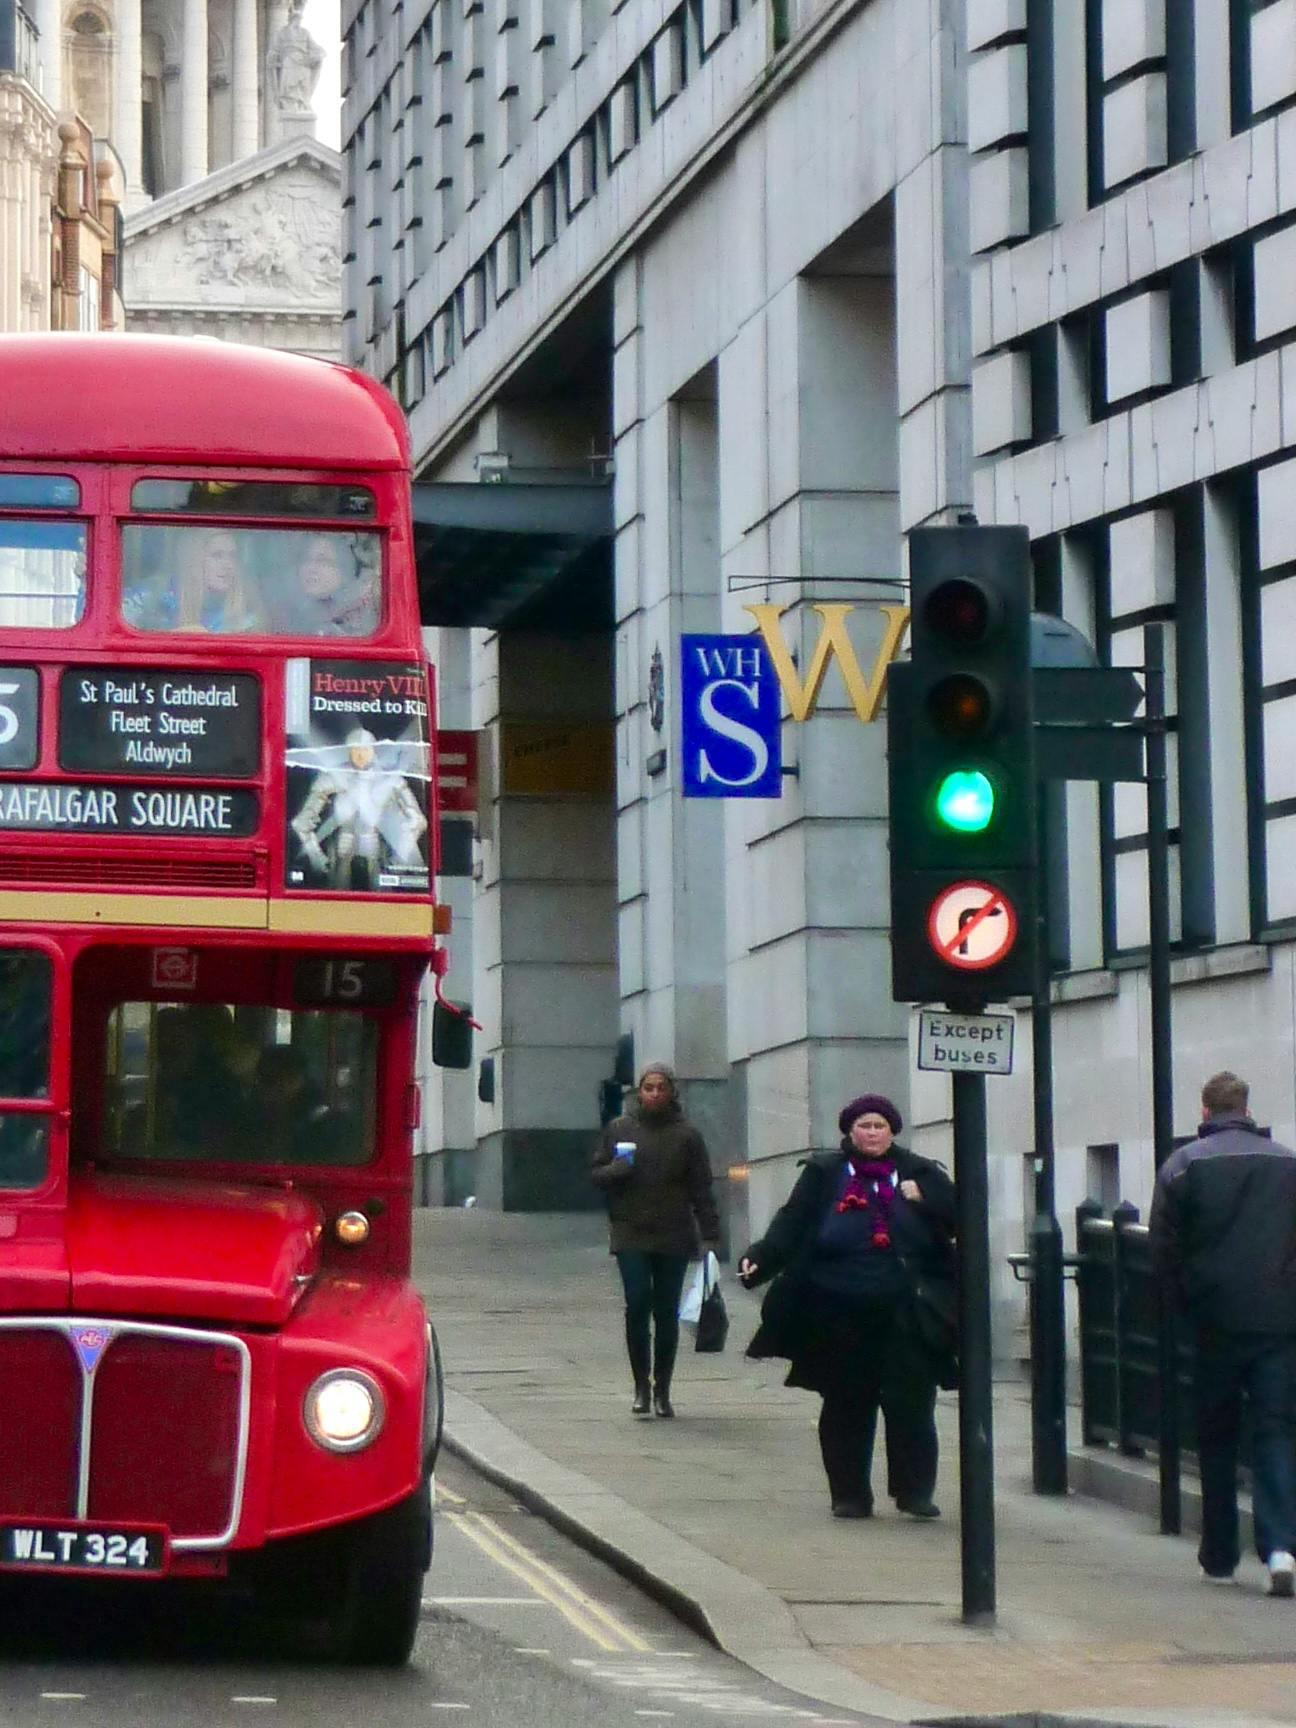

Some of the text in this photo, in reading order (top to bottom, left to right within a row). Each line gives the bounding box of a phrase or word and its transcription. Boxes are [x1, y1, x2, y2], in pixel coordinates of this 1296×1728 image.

[695, 647, 763, 677] WH
[80, 680, 238, 707] St Paul's Cathedral
[313, 673, 386, 698] Henry
[313, 696, 381, 713] Dressed
[385, 699, 403, 714] to
[111, 711, 207, 735] Fleet Street
[699, 678, 769, 786] S
[125, 740, 192, 768] Aldwych
[131, 791, 233, 829] SQUARE
[323, 960, 366, 997] 15
[929, 1020, 1004, 1043] Except
[934, 1043, 997, 1065] buses
[13, 1528, 149, 1565] WLT 324
